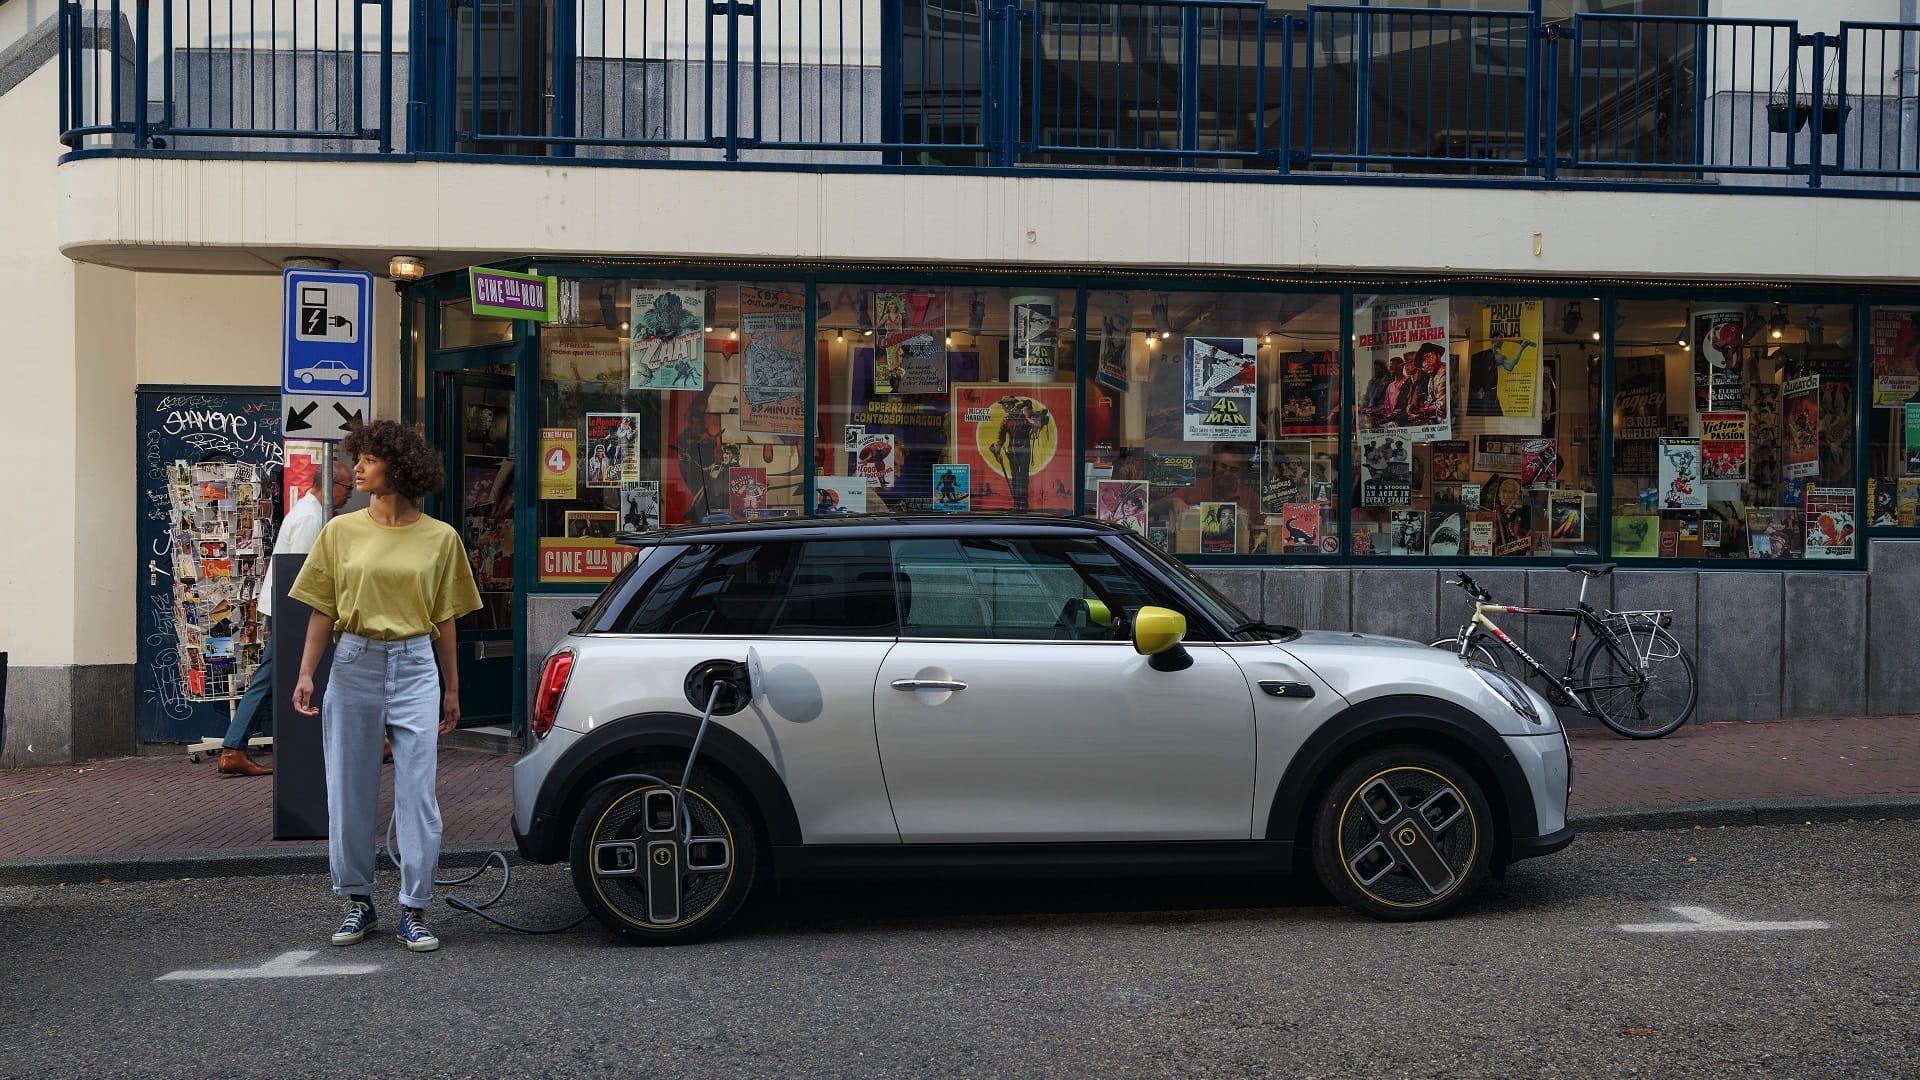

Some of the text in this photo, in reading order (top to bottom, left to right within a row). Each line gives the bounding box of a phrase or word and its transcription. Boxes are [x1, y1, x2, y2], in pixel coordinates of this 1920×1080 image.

[477, 277, 544, 308] CINE QUA NON
[747, 299, 777, 309] OUTLAW
[1373, 315, 1432, 333] I QUATTRO
[1386, 331, 1407, 345] AVE
[1408, 326, 1446, 343] MARIA
[1783, 376, 1818, 394] ALLIGATOR
[1212, 397, 1239, 414] 4D
[1614, 390, 1666, 412] Cagney
[853, 412, 943, 427] CONTROSPIONAGGIO
[1205, 413, 1247, 424] MAN
[1636, 415, 1658, 427] RUE
[1612, 427, 1667, 440] MADELEINE
[1703, 420, 1745, 436] Victims
[1711, 431, 1745, 440] PASSION
[548, 449, 567, 471] 4
[1163, 457, 1194, 465] 20000
[1263, 485, 1269, 494] 3
[1366, 497, 1386, 505] EVERY
[545, 549, 639, 573] CINE QUA NO
[1499, 634, 1540, 669] MERIDA
[1277, 686, 1286, 694] S
